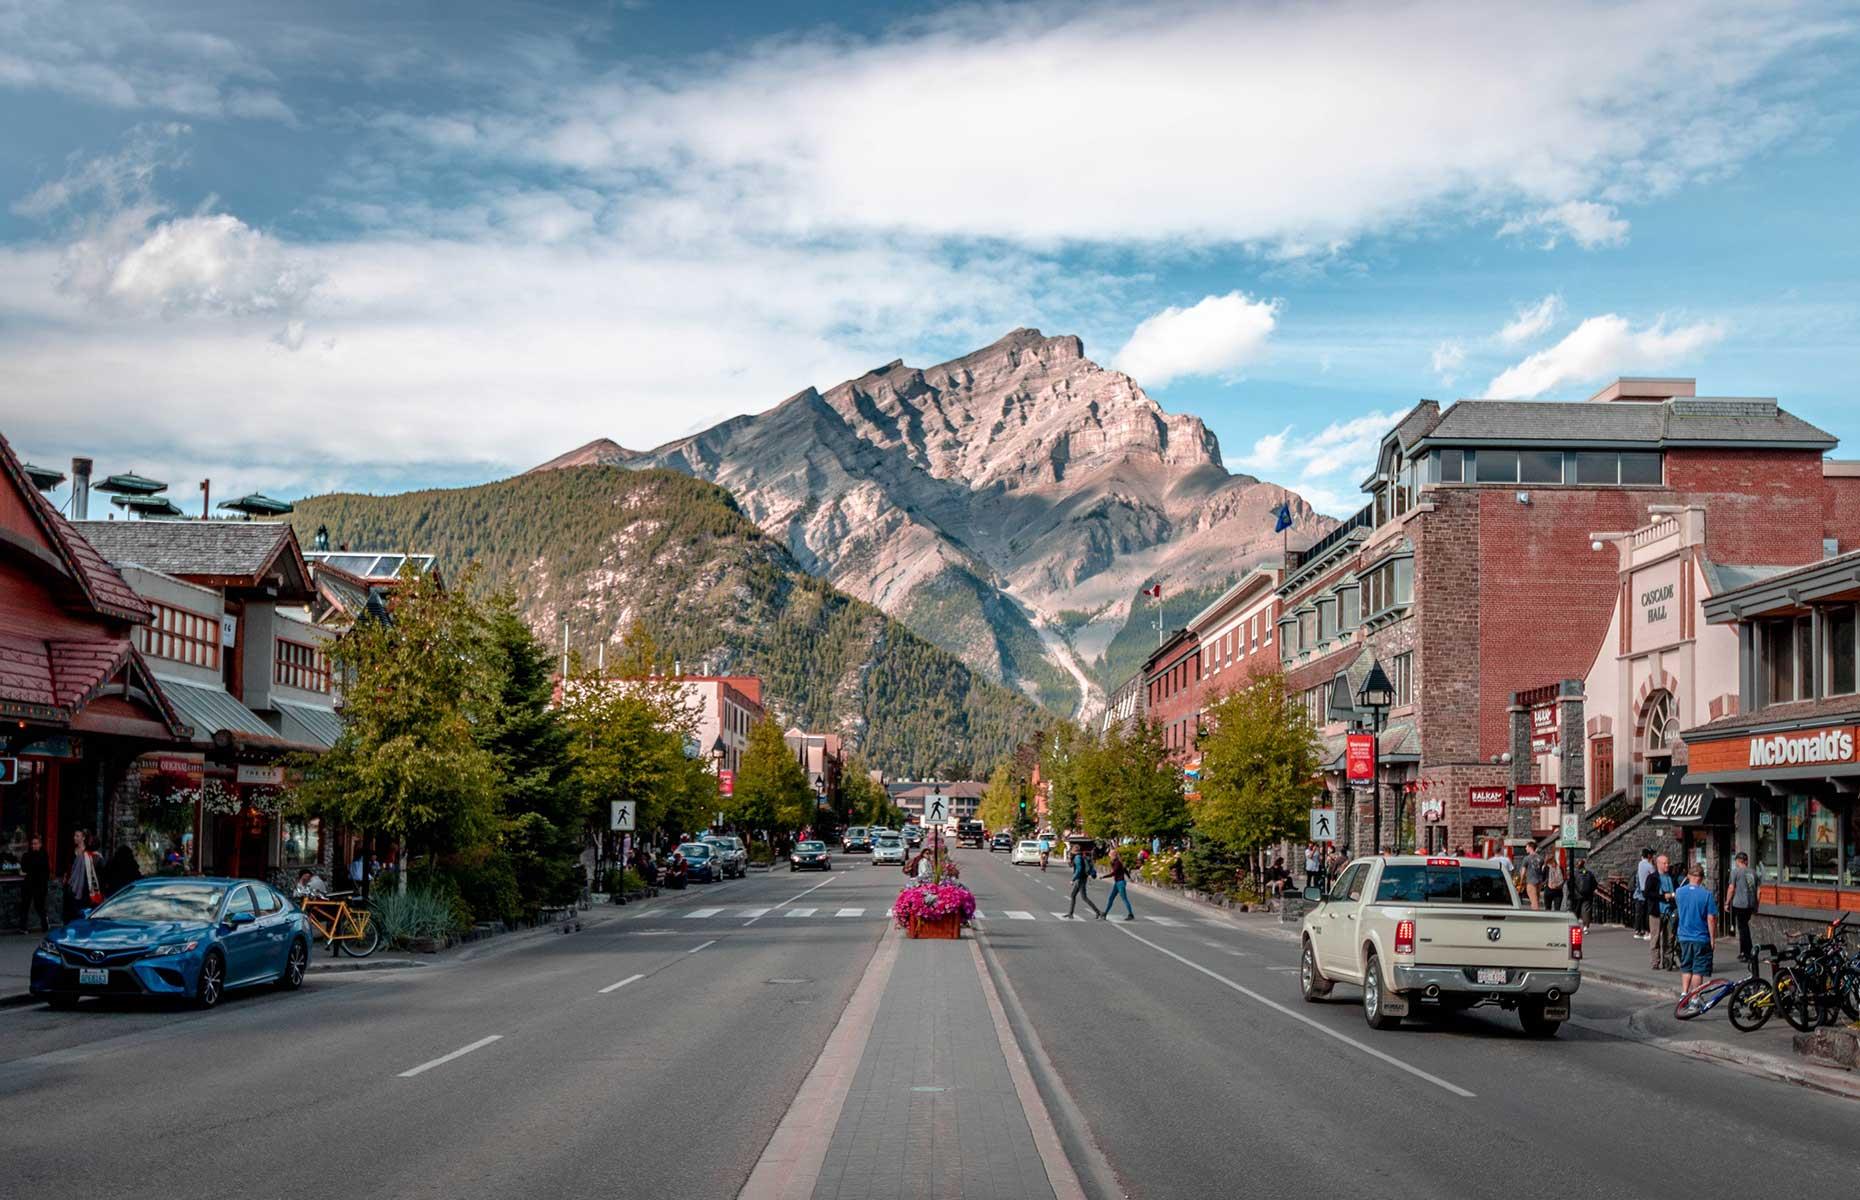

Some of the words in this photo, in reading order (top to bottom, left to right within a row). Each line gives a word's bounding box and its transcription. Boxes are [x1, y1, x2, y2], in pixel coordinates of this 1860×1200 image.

[1641, 584, 1674, 607] CASCADE
[1647, 605, 1667, 624] HALL
[1750, 731, 1853, 766] McDonald's
[1660, 793, 1703, 816] CHAYA
